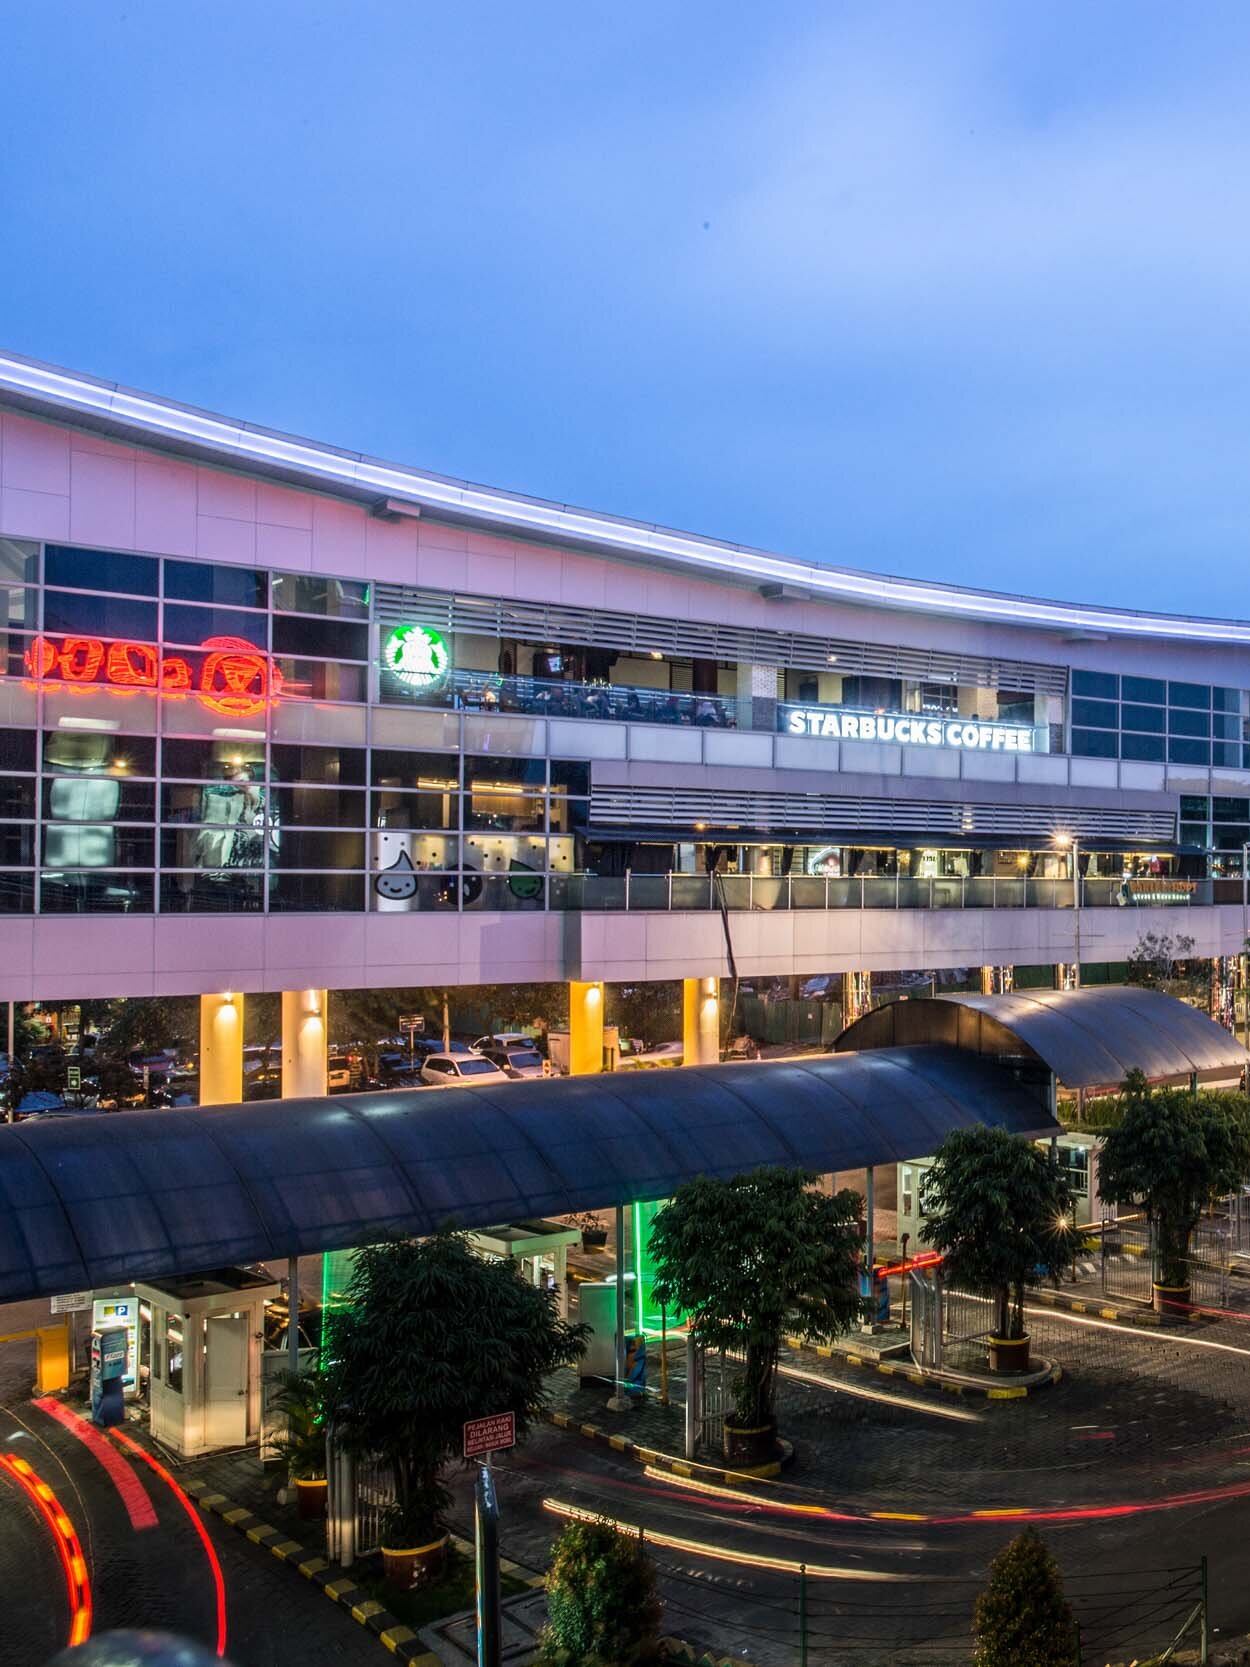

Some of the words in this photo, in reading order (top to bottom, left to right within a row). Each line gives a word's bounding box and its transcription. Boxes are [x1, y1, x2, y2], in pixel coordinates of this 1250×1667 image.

[789, 711, 942, 745] STARBUCKS
[946, 724, 1032, 752] COFFEE
[467, 1419, 496, 1431] PEJALAN
[470, 1423, 509, 1439] DILARANG
